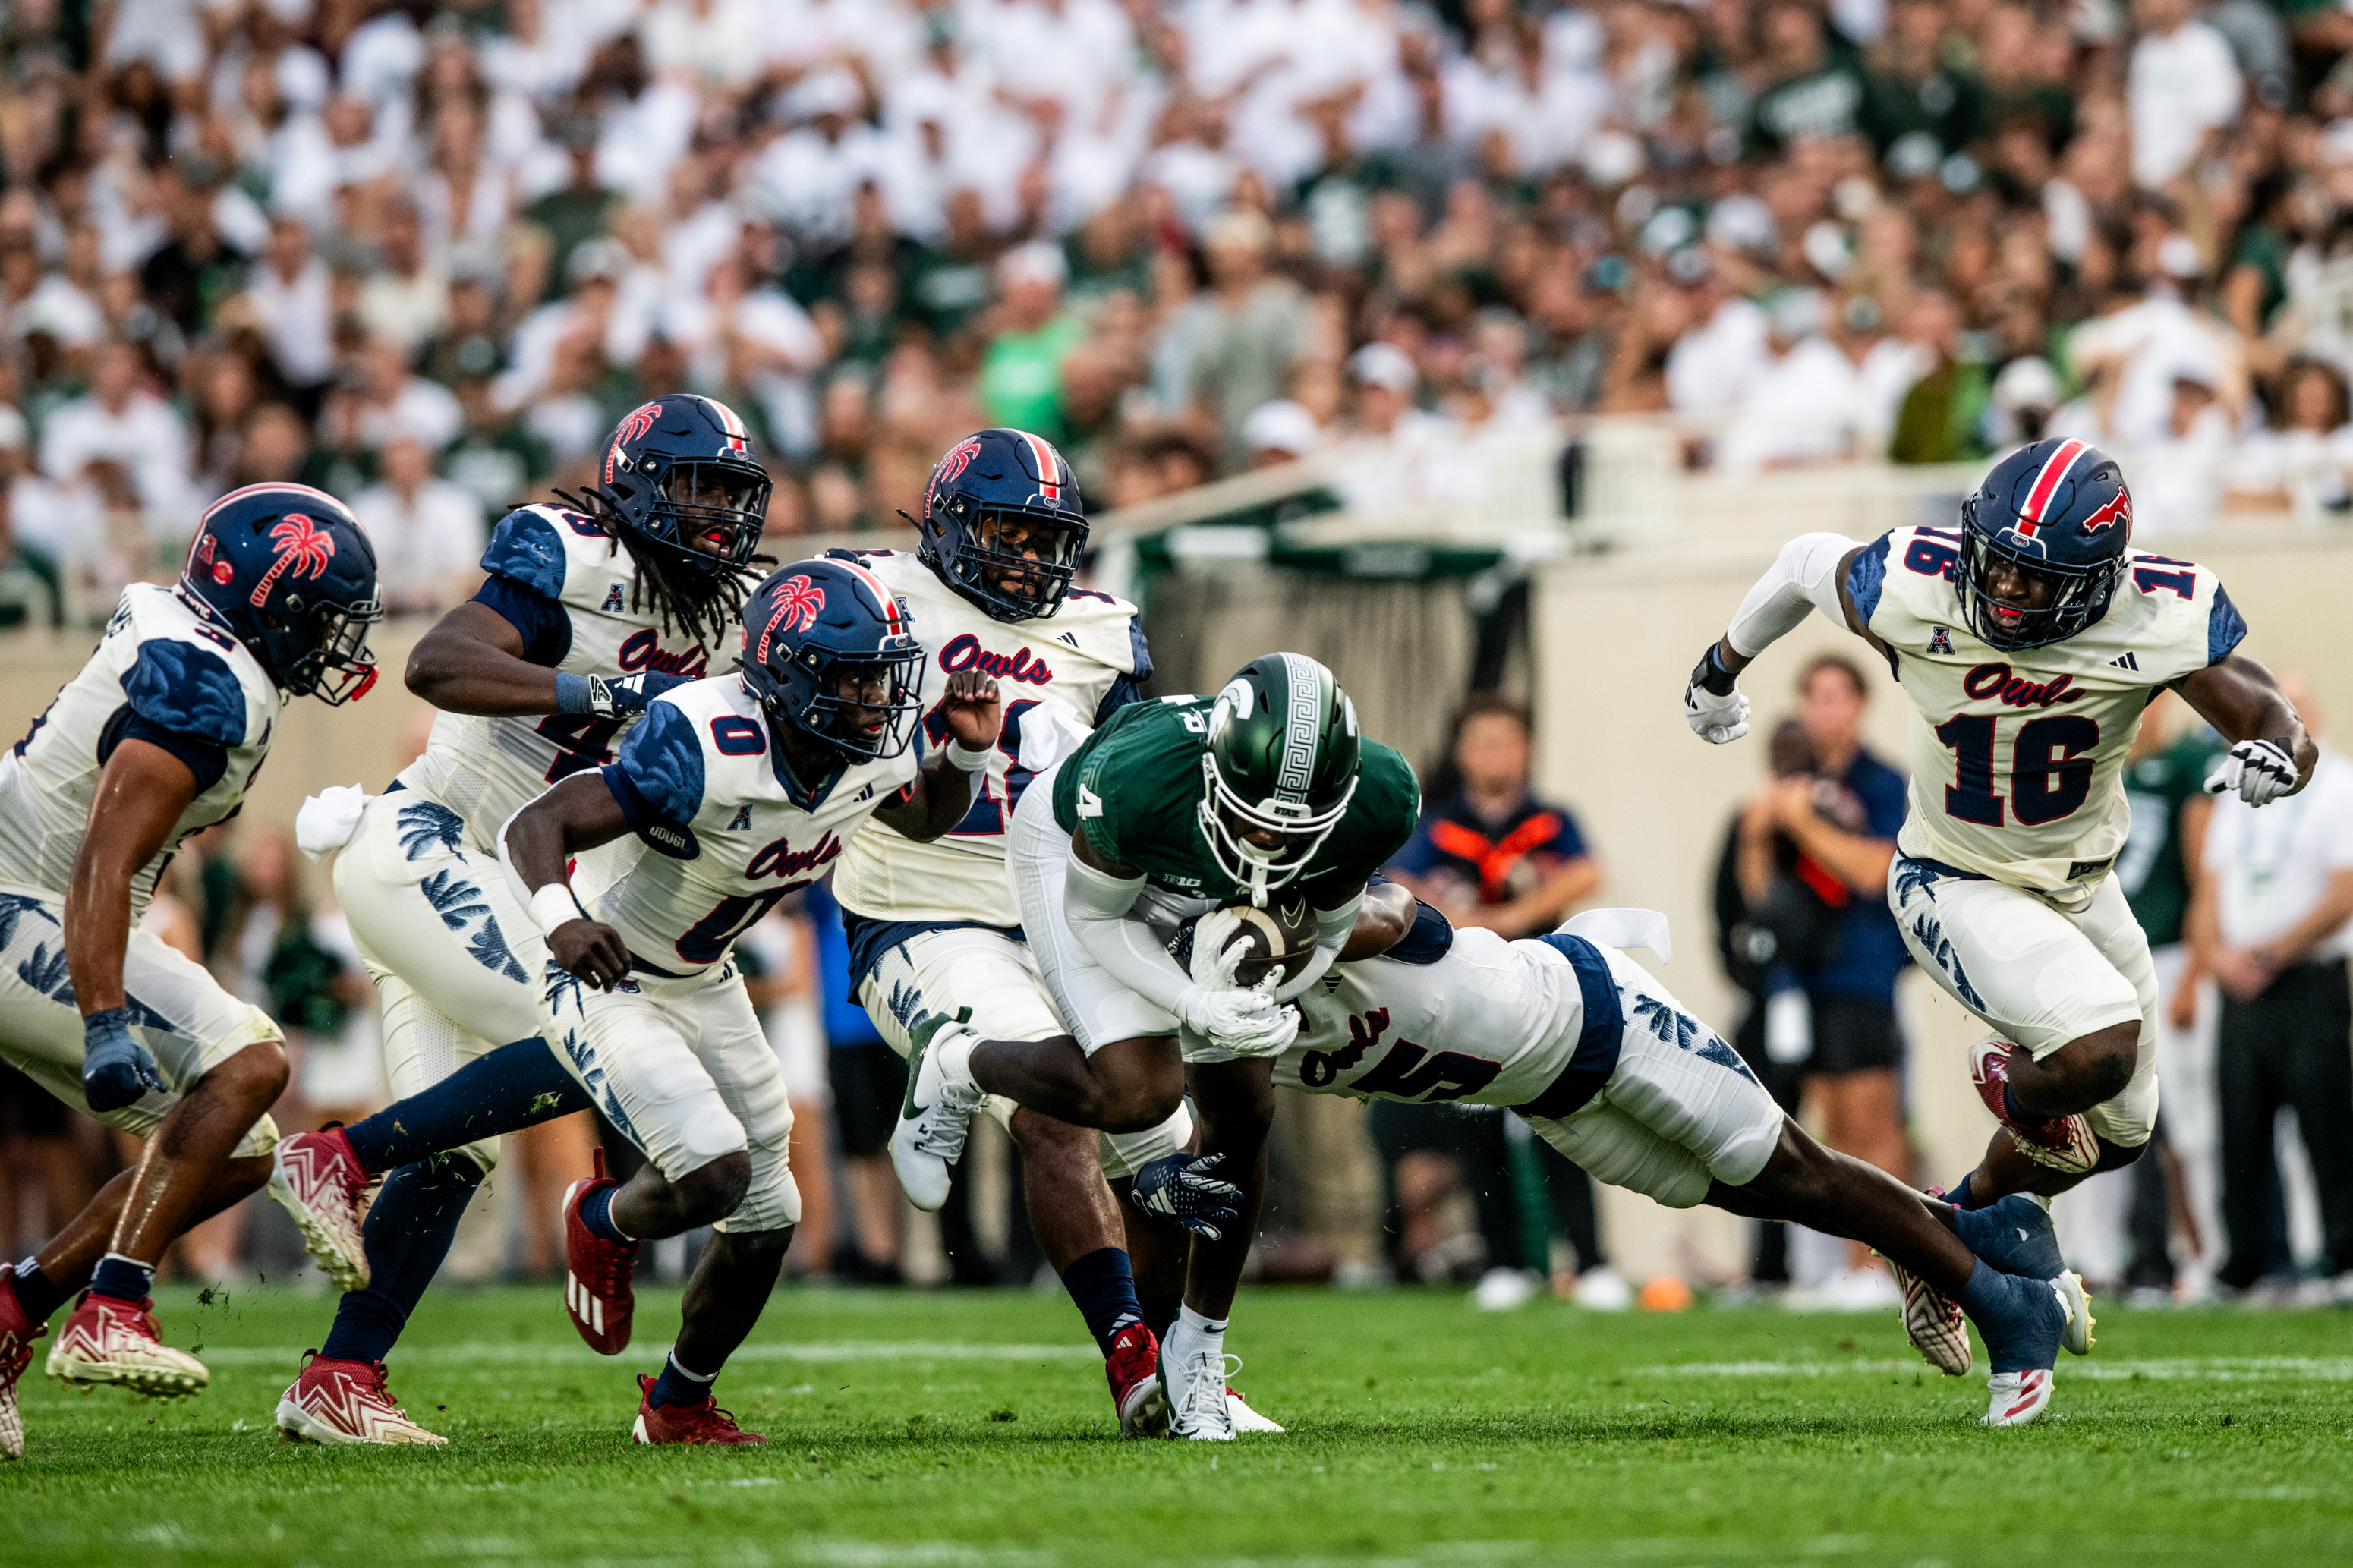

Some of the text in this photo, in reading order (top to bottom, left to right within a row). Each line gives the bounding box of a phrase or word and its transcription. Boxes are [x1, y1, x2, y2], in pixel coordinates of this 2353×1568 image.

[619, 628, 708, 681] Owls
[938, 633, 1054, 685] Owls
[710, 714, 767, 756] 0
[1935, 712, 2100, 828] 16
[1076, 782, 1104, 820] 4
[1274, 805, 1302, 817] STATE
[745, 828, 843, 880] Owls
[1299, 1006, 1391, 1088] Owls
[1347, 1037, 1503, 1102] 5
